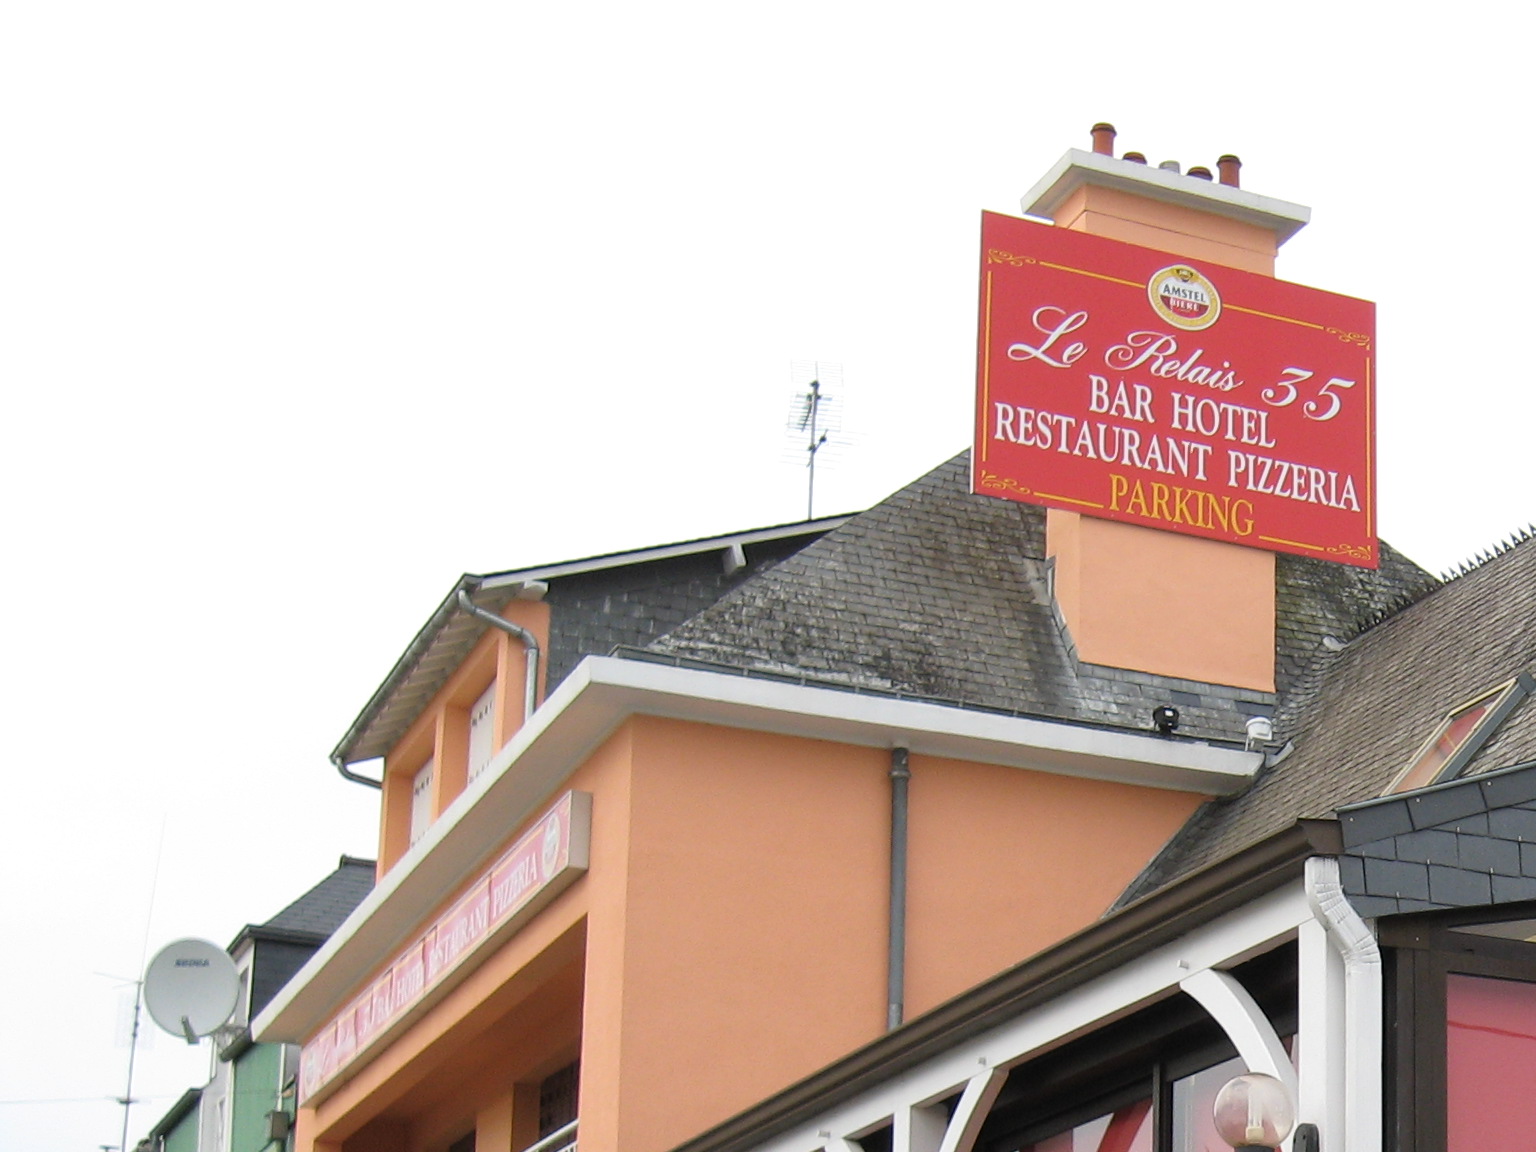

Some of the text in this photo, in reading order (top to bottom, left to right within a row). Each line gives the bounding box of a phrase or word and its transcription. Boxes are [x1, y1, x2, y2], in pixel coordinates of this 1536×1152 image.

[1162, 282, 1207, 303] AMSTEL
[1007, 306, 1356, 422] Le Relais 35
[1088, 374, 1277, 449] BAR HOTEL
[993, 402, 1361, 512] RESTAURANT PIZZERIA
[1108, 474, 1255, 537] PARKING
